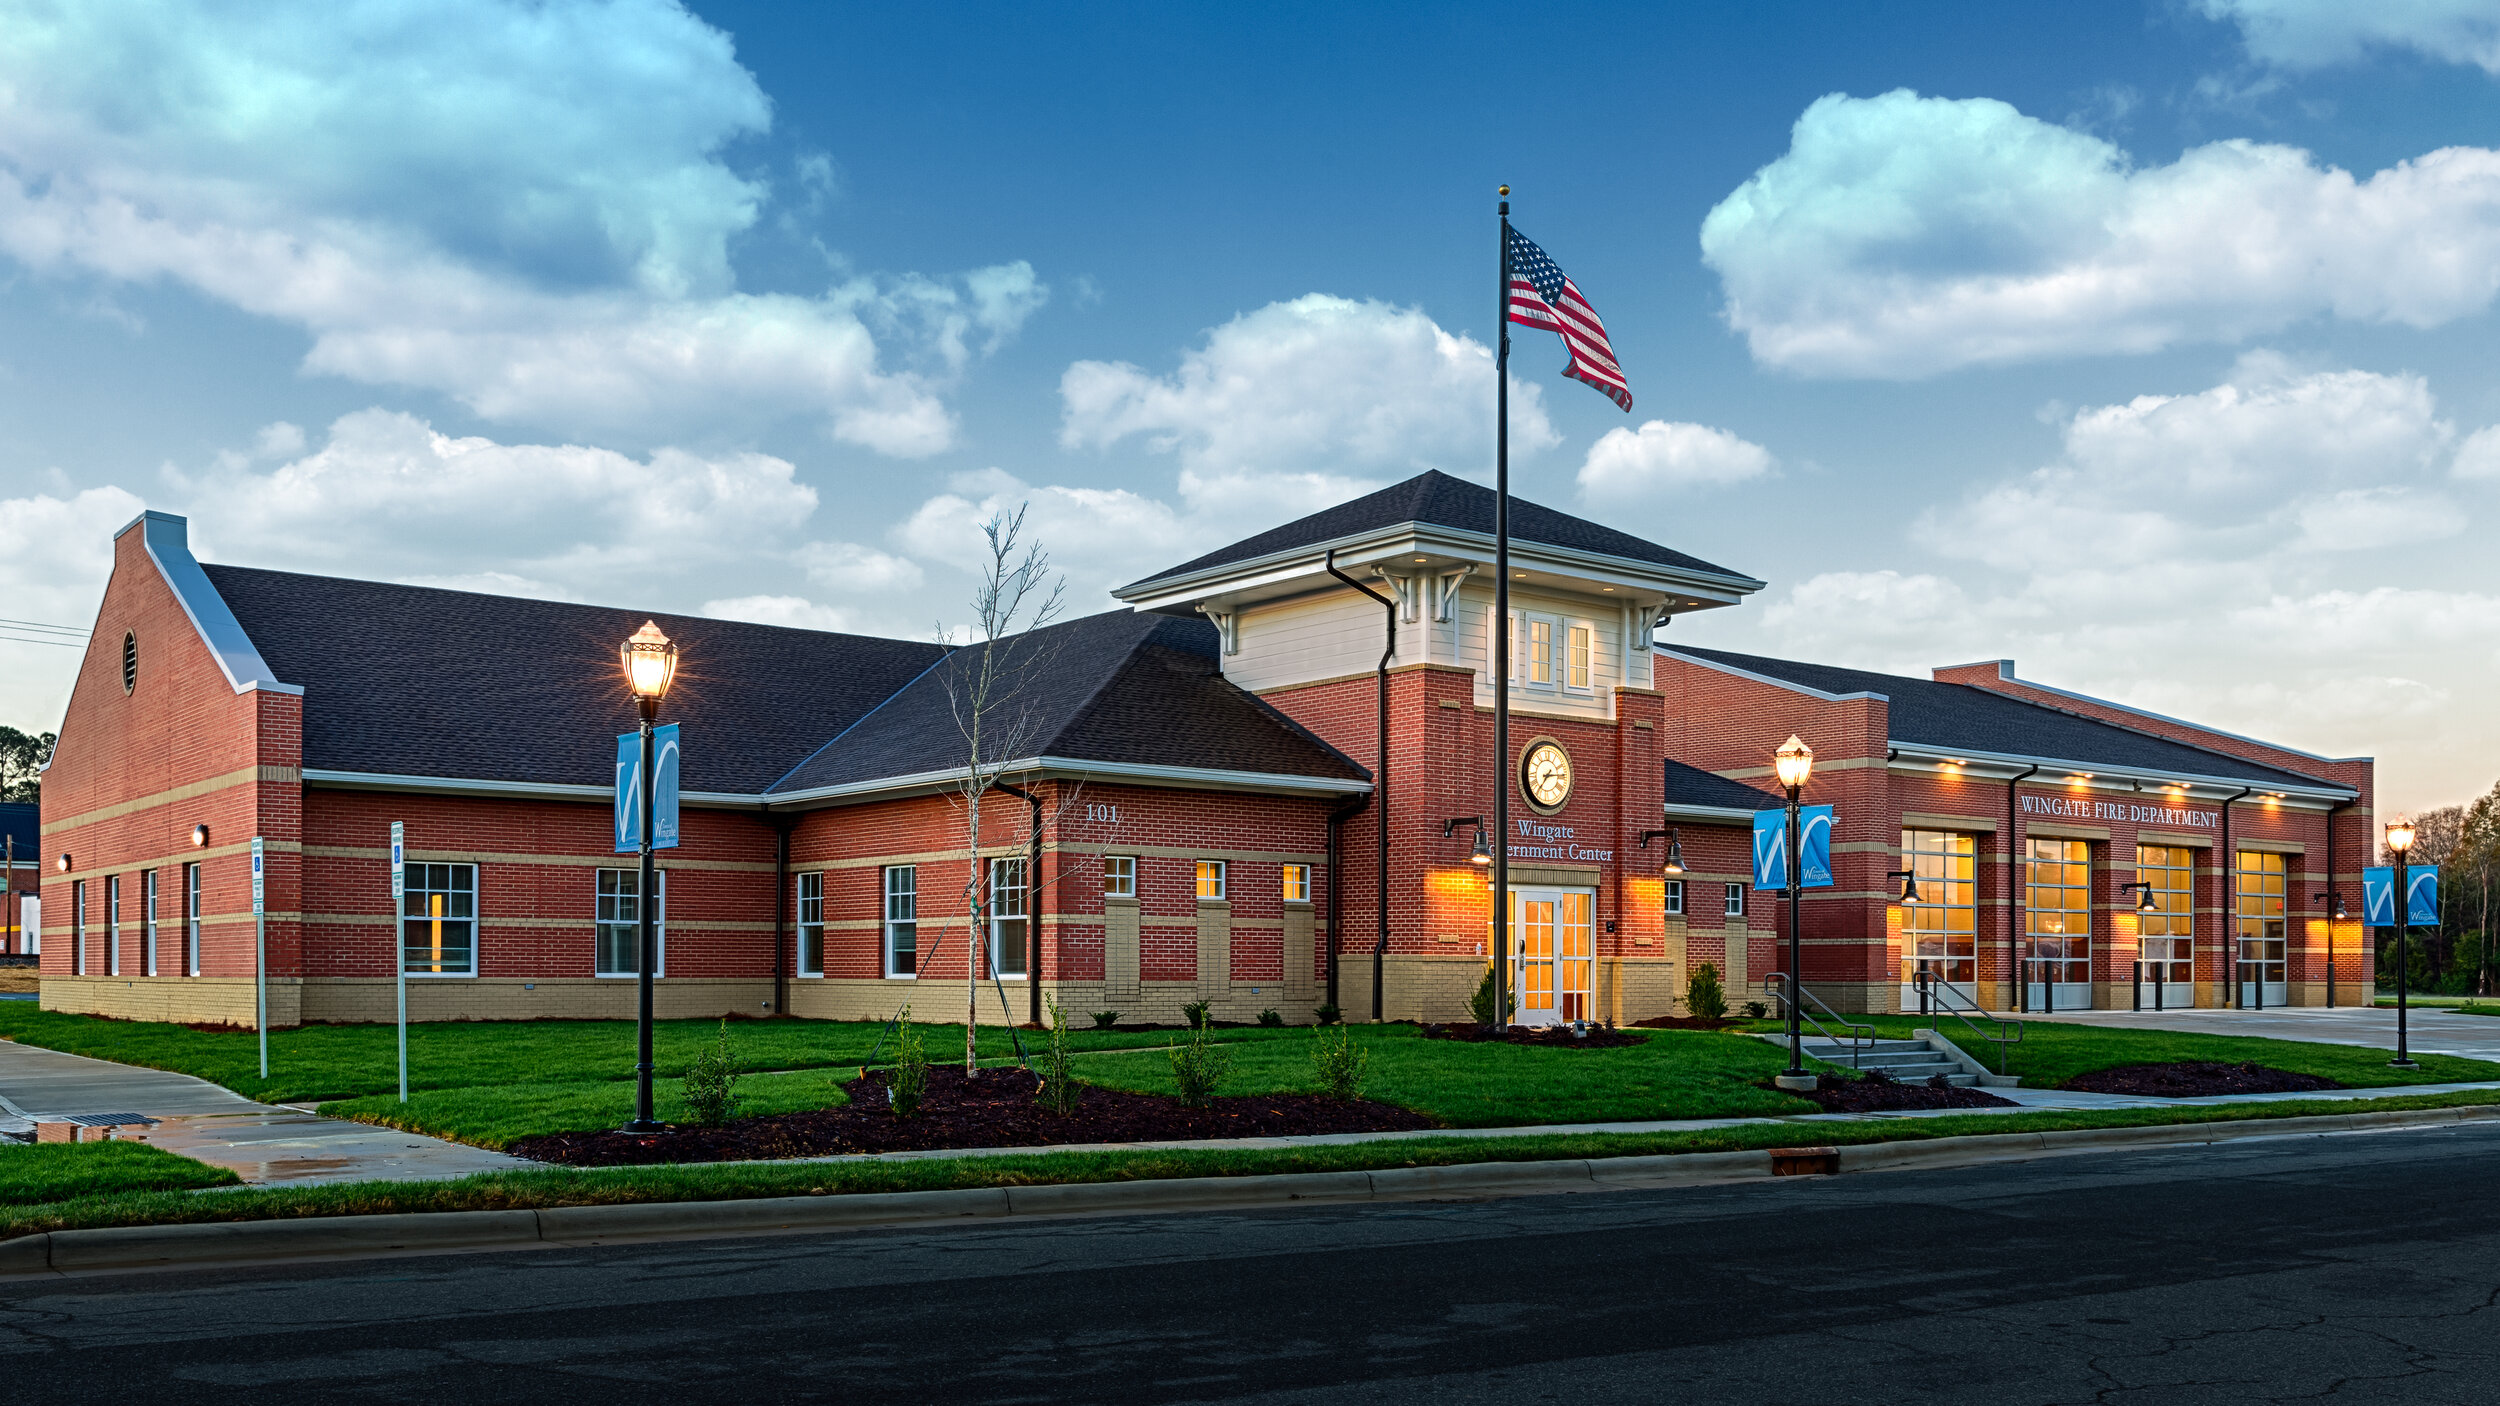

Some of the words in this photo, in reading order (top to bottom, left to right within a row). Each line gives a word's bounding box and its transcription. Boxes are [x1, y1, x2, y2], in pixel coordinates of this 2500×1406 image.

[1086, 804, 1118, 822] 101
[2021, 796, 2090, 817] WINGATE
[2095, 802, 2126, 820] FIRE
[2131, 805, 2218, 828] DEPARTMENT
[1518, 820, 1575, 843] Wingate
[1569, 844, 1613, 861] Center
[1803, 866, 1830, 881] Wingate
